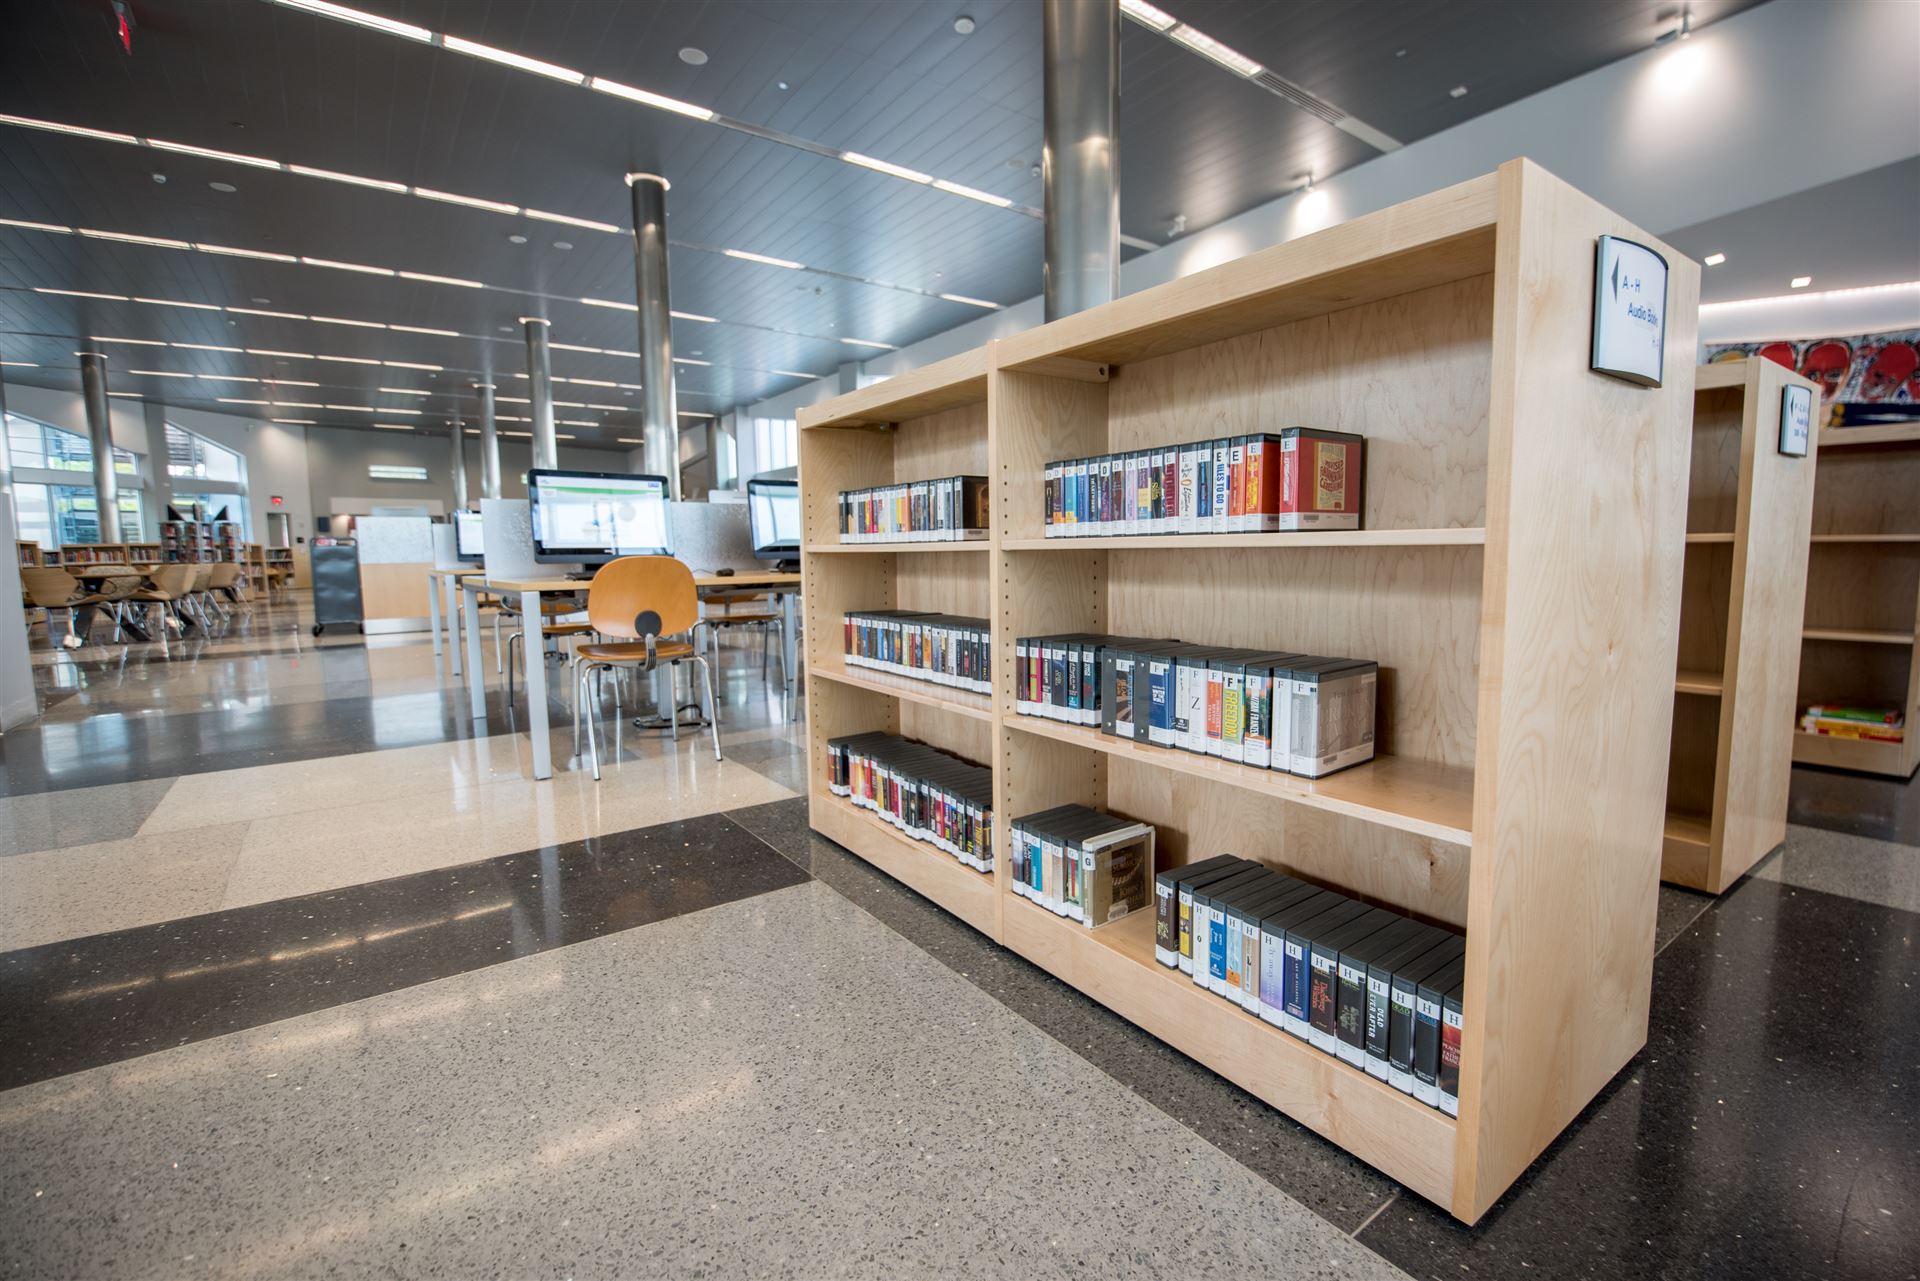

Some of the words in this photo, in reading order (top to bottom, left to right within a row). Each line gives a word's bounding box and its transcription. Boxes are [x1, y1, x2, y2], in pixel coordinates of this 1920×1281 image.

[1622, 275, 1629, 290] A
[1635, 278, 1641, 293] H
[1628, 302, 1646, 321] Audio
[1216, 483, 1225, 492] TO
[1216, 493, 1224, 504] GO
[1191, 696, 1200, 710] Z
[1225, 691, 1238, 737] FREEDOM
[1368, 1013, 1376, 1038] AFTER
[1376, 1007, 1384, 1028] DEAD
